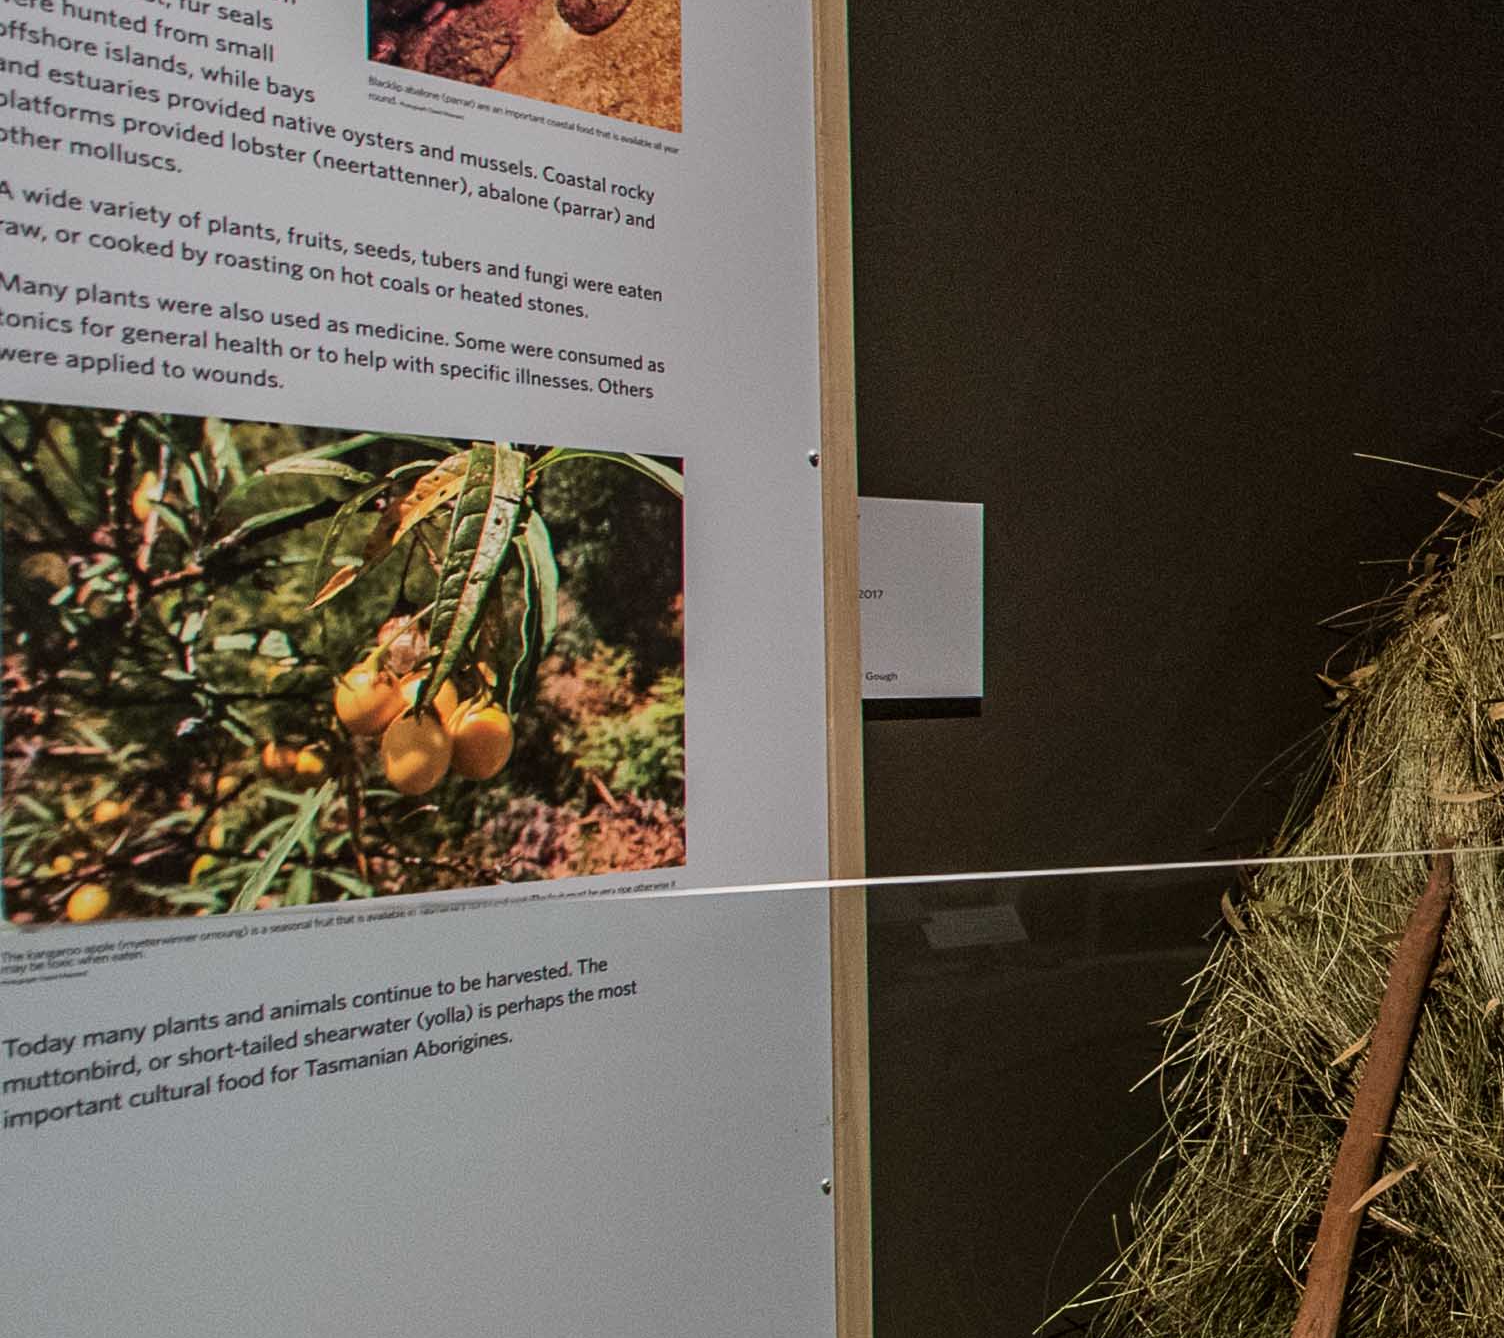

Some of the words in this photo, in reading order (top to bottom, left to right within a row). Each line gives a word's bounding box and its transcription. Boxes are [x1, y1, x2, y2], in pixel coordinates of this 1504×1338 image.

[47, 68, 161, 104] estuaries
[167, 92, 266, 124] provided
[272, 114, 337, 139] native
[341, 128, 415, 155] oysters
[419, 144, 455, 163] and
[460, 152, 538, 180] mussels.
[542, 165, 607, 194] Coastal
[610, 183, 655, 206] rocky
[22, 187, 83, 211] wide
[89, 199, 172, 229] variety
[178, 210, 202, 230] of
[208, 215, 281, 245] plants,
[287, 226, 349, 256] fruits,
[353, 241, 417, 266] seeds,
[421, 249, 482, 274] tubers
[486, 263, 520, 280] and
[524, 264, 568, 291] fungi
[572, 277, 614, 295] were
[617, 284, 663, 302] eaten
[859, 589, 884, 599] 2017
[865, 671, 898, 682] Gough
[1, 1034, 77, 1058] Today
[82, 1025, 147, 1048] many
[152, 1013, 220, 1042] plants
[224, 1003, 265, 1028] and
[269, 993, 348, 1021] animals
[351, 985, 433, 1009] continue
[436, 980, 456, 996] to
[459, 975, 482, 993] be
[486, 960, 573, 989] harvested.
[576, 957, 608, 976] The
[2, 1055, 143, 1094] muttonbird,
[148, 1054, 173, 1072] or
[177, 1029, 298, 1067] short-tailed
[303, 1017, 412, 1048] shearwater
[416, 1003, 474, 1032] (yolla)
[478, 1002, 493, 1020] is
[496, 994, 565, 1020] perhaps
[567, 987, 595, 1005] the
[597, 980, 638, 1001] most
[3, 1092, 123, 1129] important
[128, 1075, 212, 1108] cultural
[216, 1067, 265, 1093] food
[270, 1064, 300, 1084] for
[304, 1047, 409, 1078] Tasmanian
[412, 1031, 513, 1060] Aborigines.
